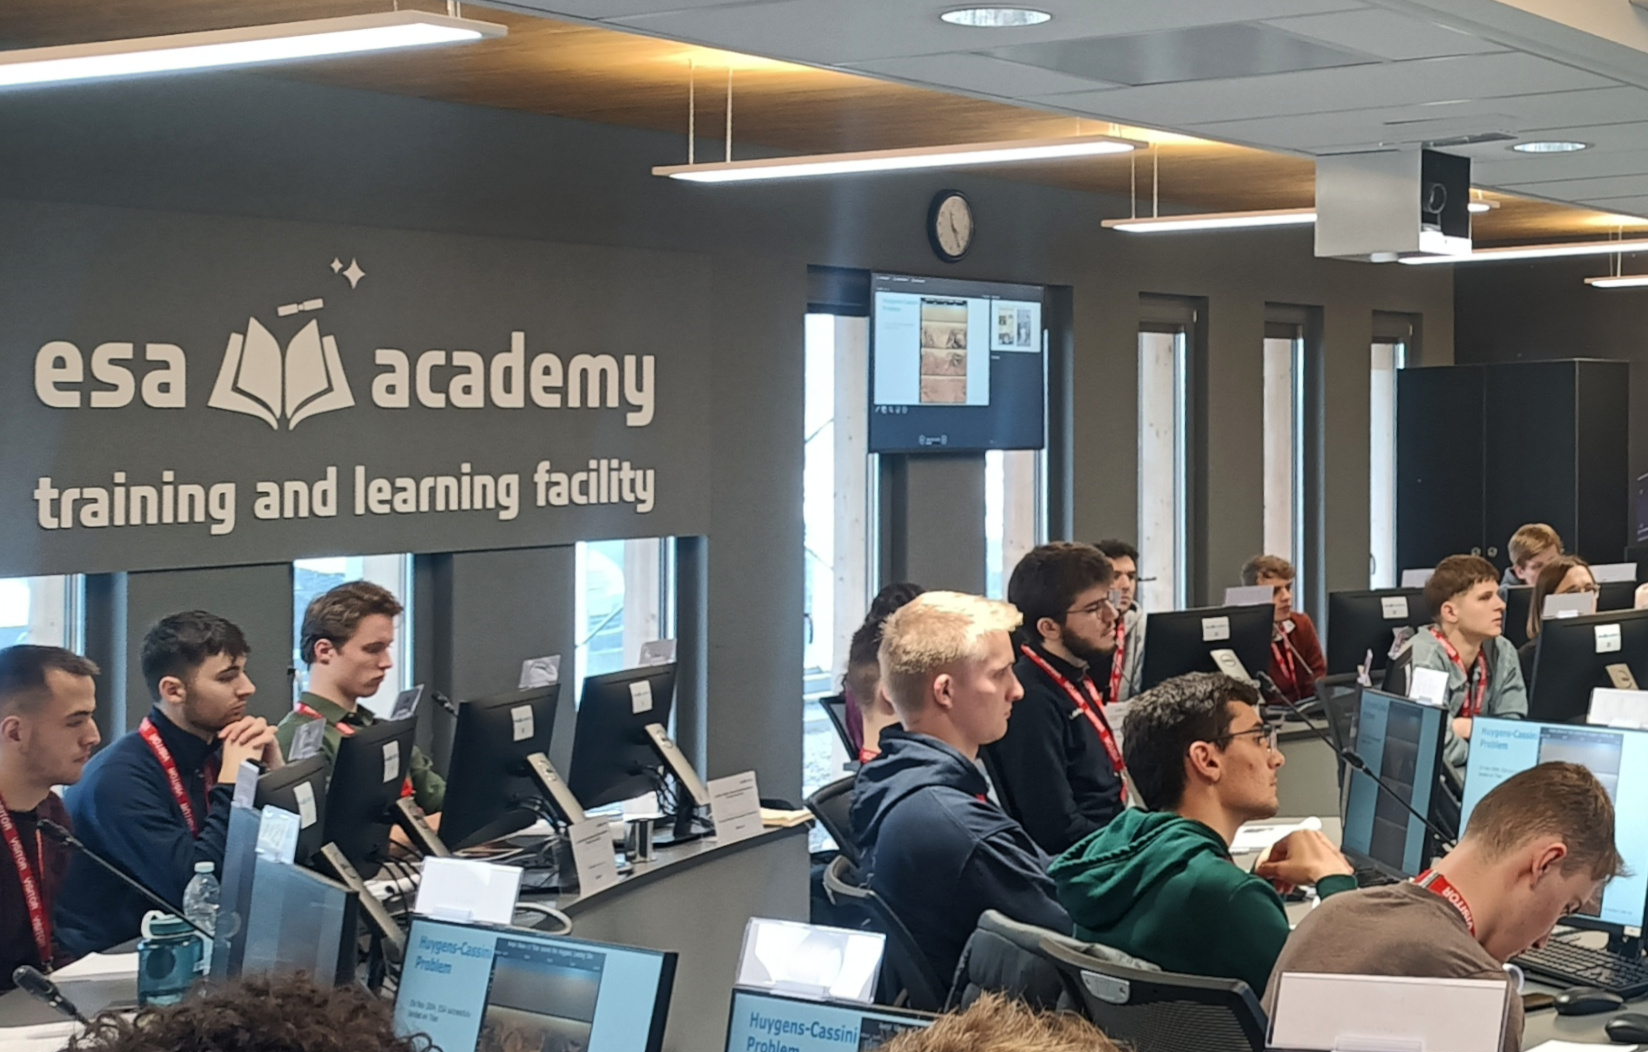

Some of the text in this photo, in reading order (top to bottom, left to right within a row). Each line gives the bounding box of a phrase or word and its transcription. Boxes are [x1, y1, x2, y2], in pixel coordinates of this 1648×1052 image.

[34, 331, 656, 426] esa academy
[33, 458, 655, 535] training and learning facility
[1442, 886, 1474, 931] VISITOR
[415, 956, 452, 974] Problem
[750, 1011, 858, 1044] Huygens-Cassini
